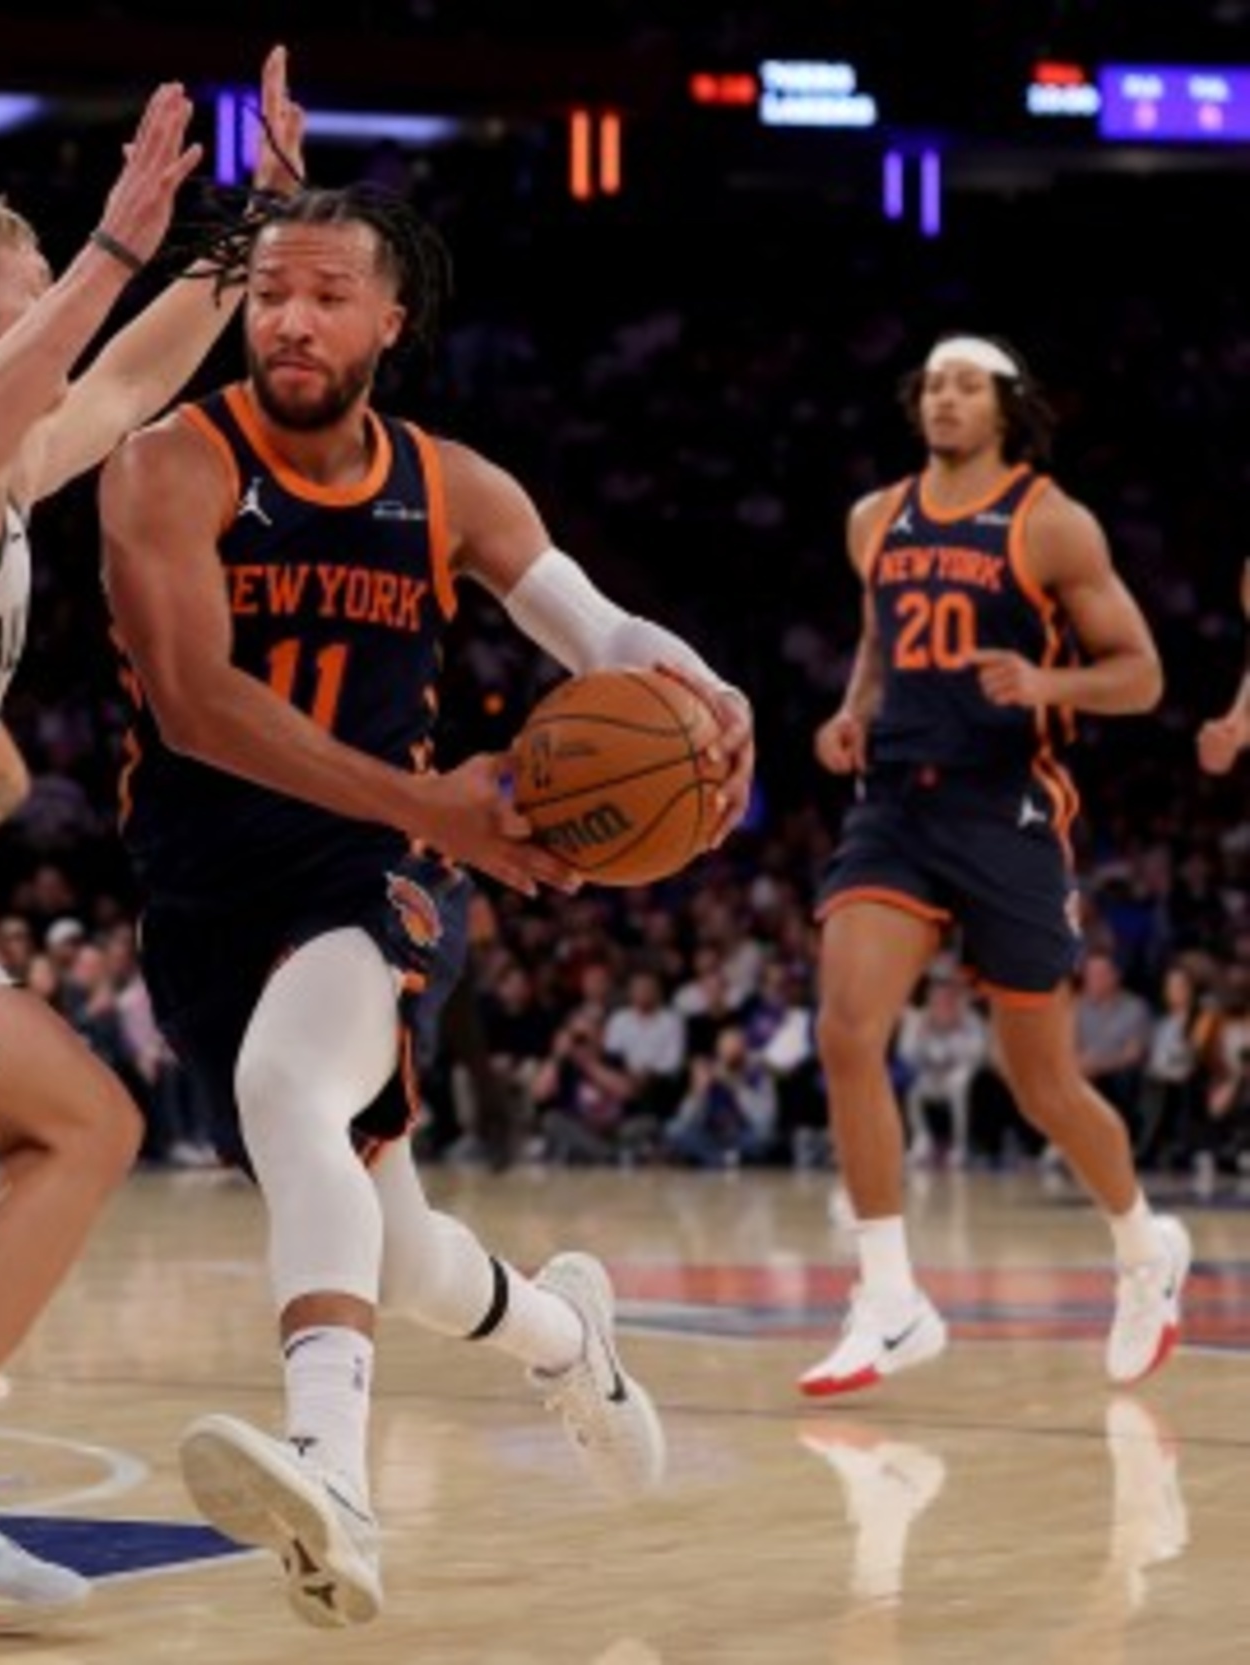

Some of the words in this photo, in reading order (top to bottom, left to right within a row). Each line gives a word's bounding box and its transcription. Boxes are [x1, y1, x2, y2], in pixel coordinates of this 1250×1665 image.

[226, 563, 309, 615] EW
[316, 564, 429, 632] YORK
[878, 547, 935, 586] NEW
[937, 547, 1005, 593] YORK
[894, 590, 977, 671] 20
[268, 637, 349, 735] 11
